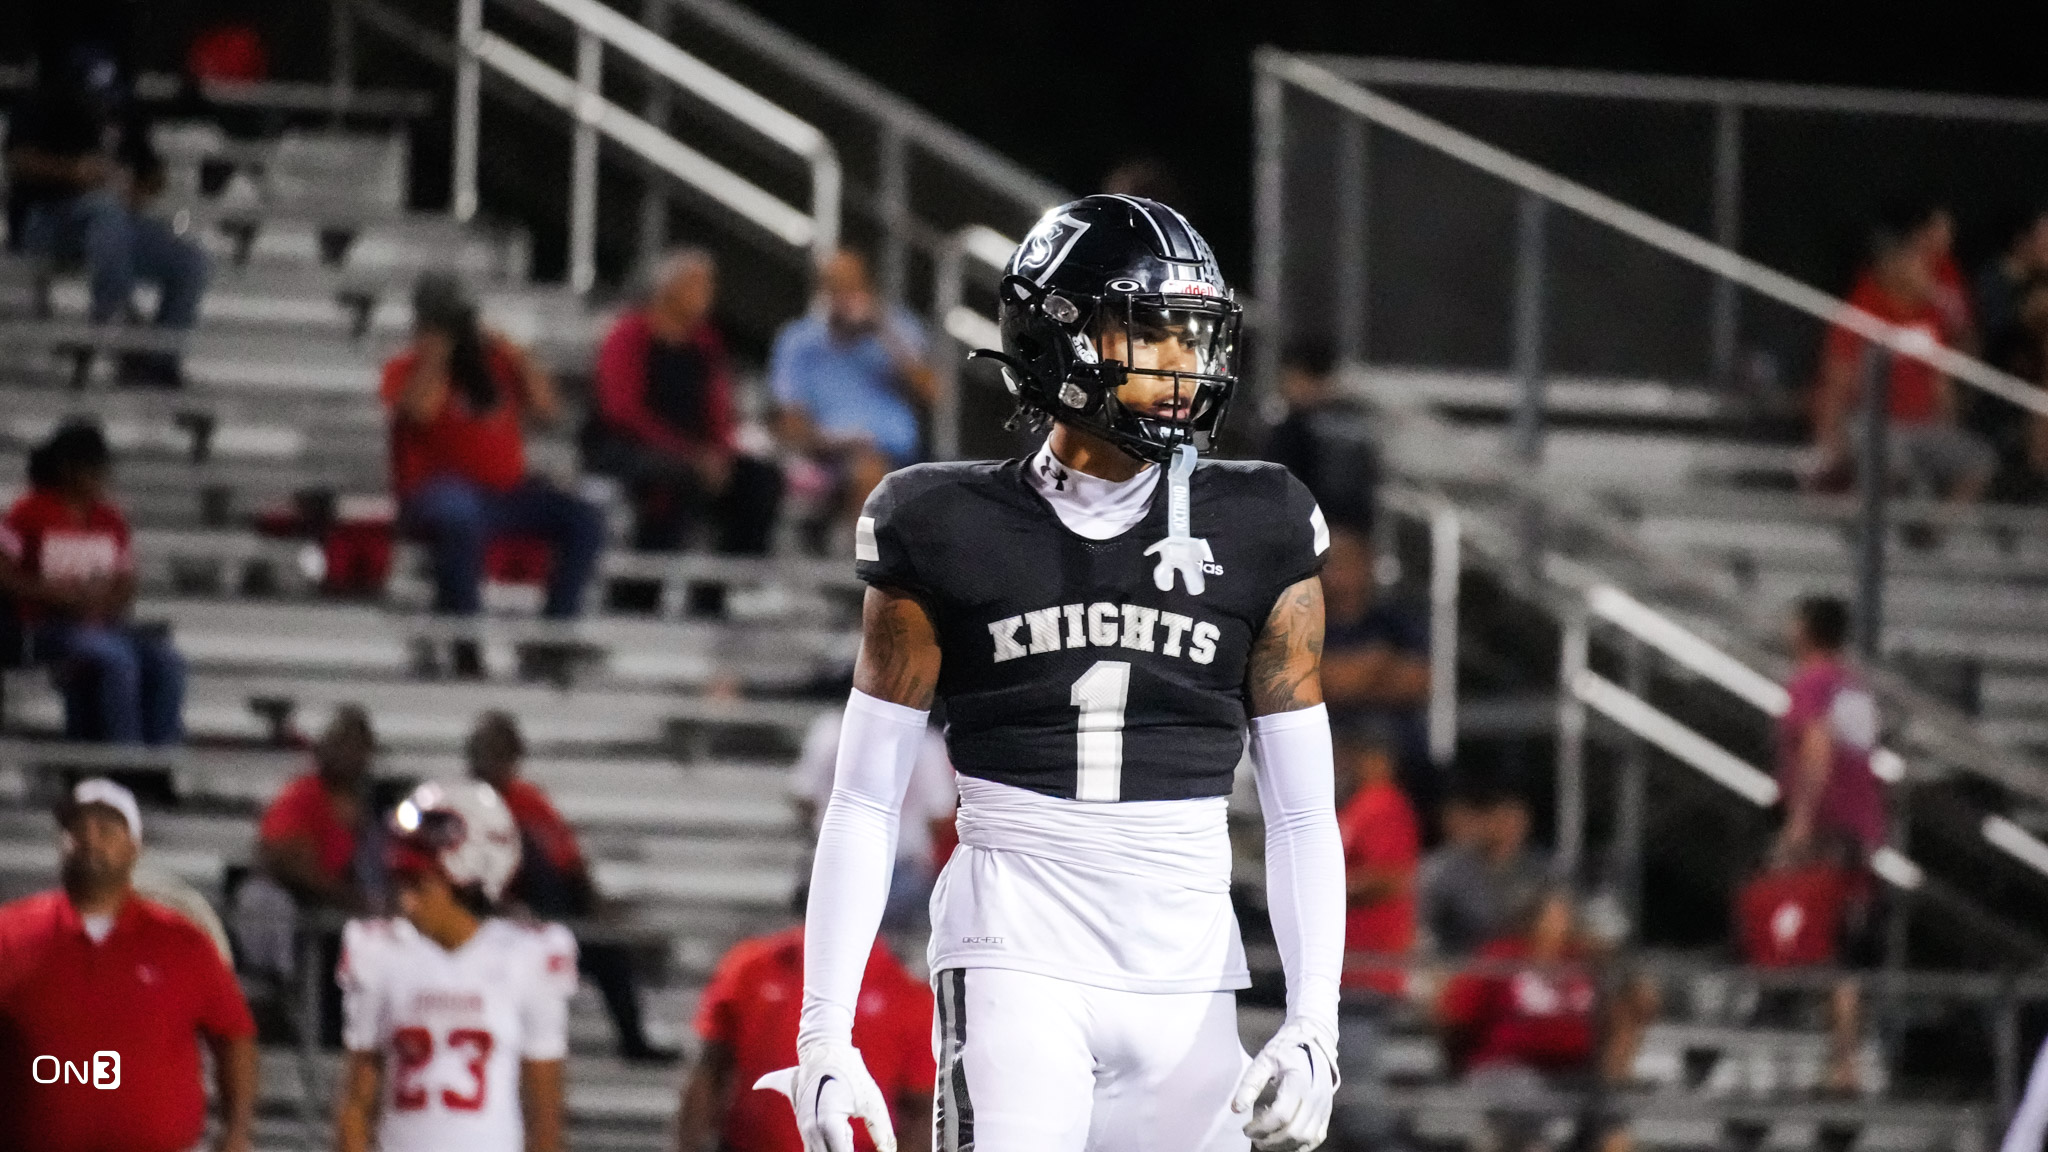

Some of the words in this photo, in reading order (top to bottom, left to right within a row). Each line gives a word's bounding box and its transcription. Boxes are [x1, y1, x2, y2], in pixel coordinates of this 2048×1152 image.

[1173, 485, 1187, 531] NXTRND
[987, 602, 1221, 665] KNIGHTS
[1070, 660, 1132, 802] 1
[962, 936, 1005, 944] DRI-FIT
[394, 1025, 495, 1111] 23
